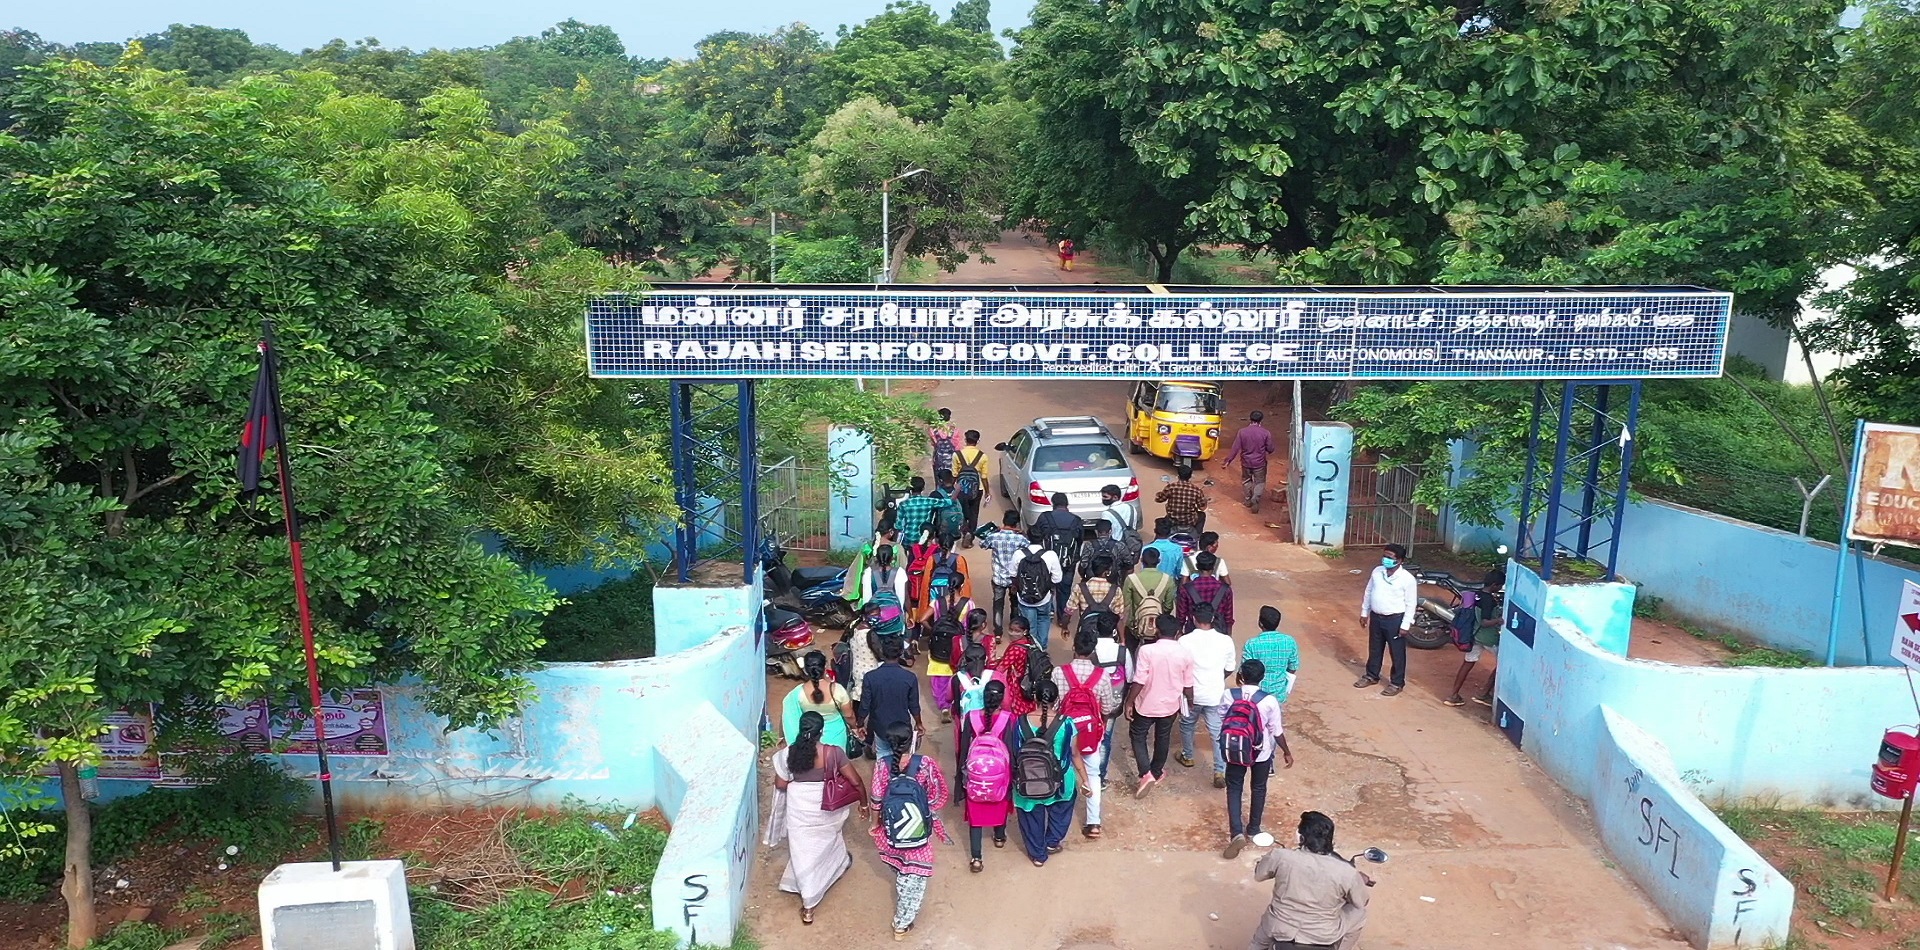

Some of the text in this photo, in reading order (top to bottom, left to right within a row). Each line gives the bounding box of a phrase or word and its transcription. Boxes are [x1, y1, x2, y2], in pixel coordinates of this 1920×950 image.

[642, 297, 808, 332] மன்னர்
[820, 300, 982, 332] சரபோசி
[989, 303, 1142, 333] அரசுக்
[1149, 301, 1306, 334] கல்லூரி
[643, 340, 793, 360] RAJAH
[799, 341, 968, 361] SERFOJI
[981, 342, 1097, 362] GOVT.
[1106, 342, 1301, 362] COLLEGE
[1569, 347, 1618, 361] ESTD
[1642, 347, 1679, 361] 1955
[1168, 363, 1202, 373] Grade
[1207, 362, 1223, 375] by
[1228, 364, 1258, 373] NAAC
[1308, 445, 1340, 547] SFI
[1637, 797, 1682, 880] SFI
[682, 873, 710, 946] SFI
[1731, 868, 1758, 946] SFI
